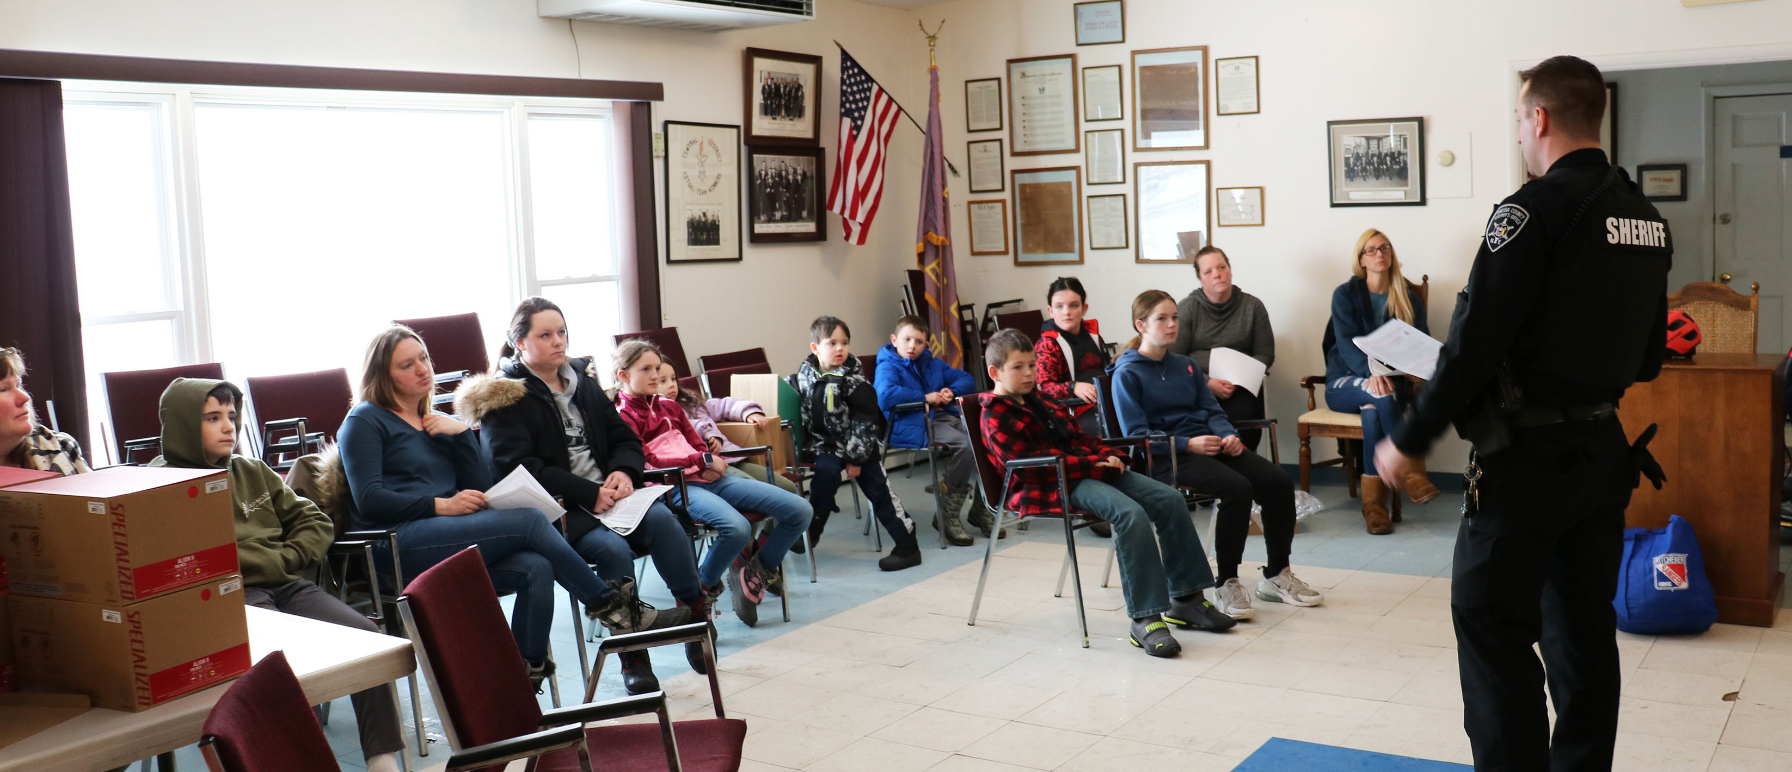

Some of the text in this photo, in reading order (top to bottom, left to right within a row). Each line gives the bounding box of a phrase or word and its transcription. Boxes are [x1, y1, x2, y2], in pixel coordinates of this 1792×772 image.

[1606, 216, 1666, 248] SHERIFF
[109, 501, 135, 601] SPECIALIZED
[126, 609, 151, 706] SPECIALIZED
